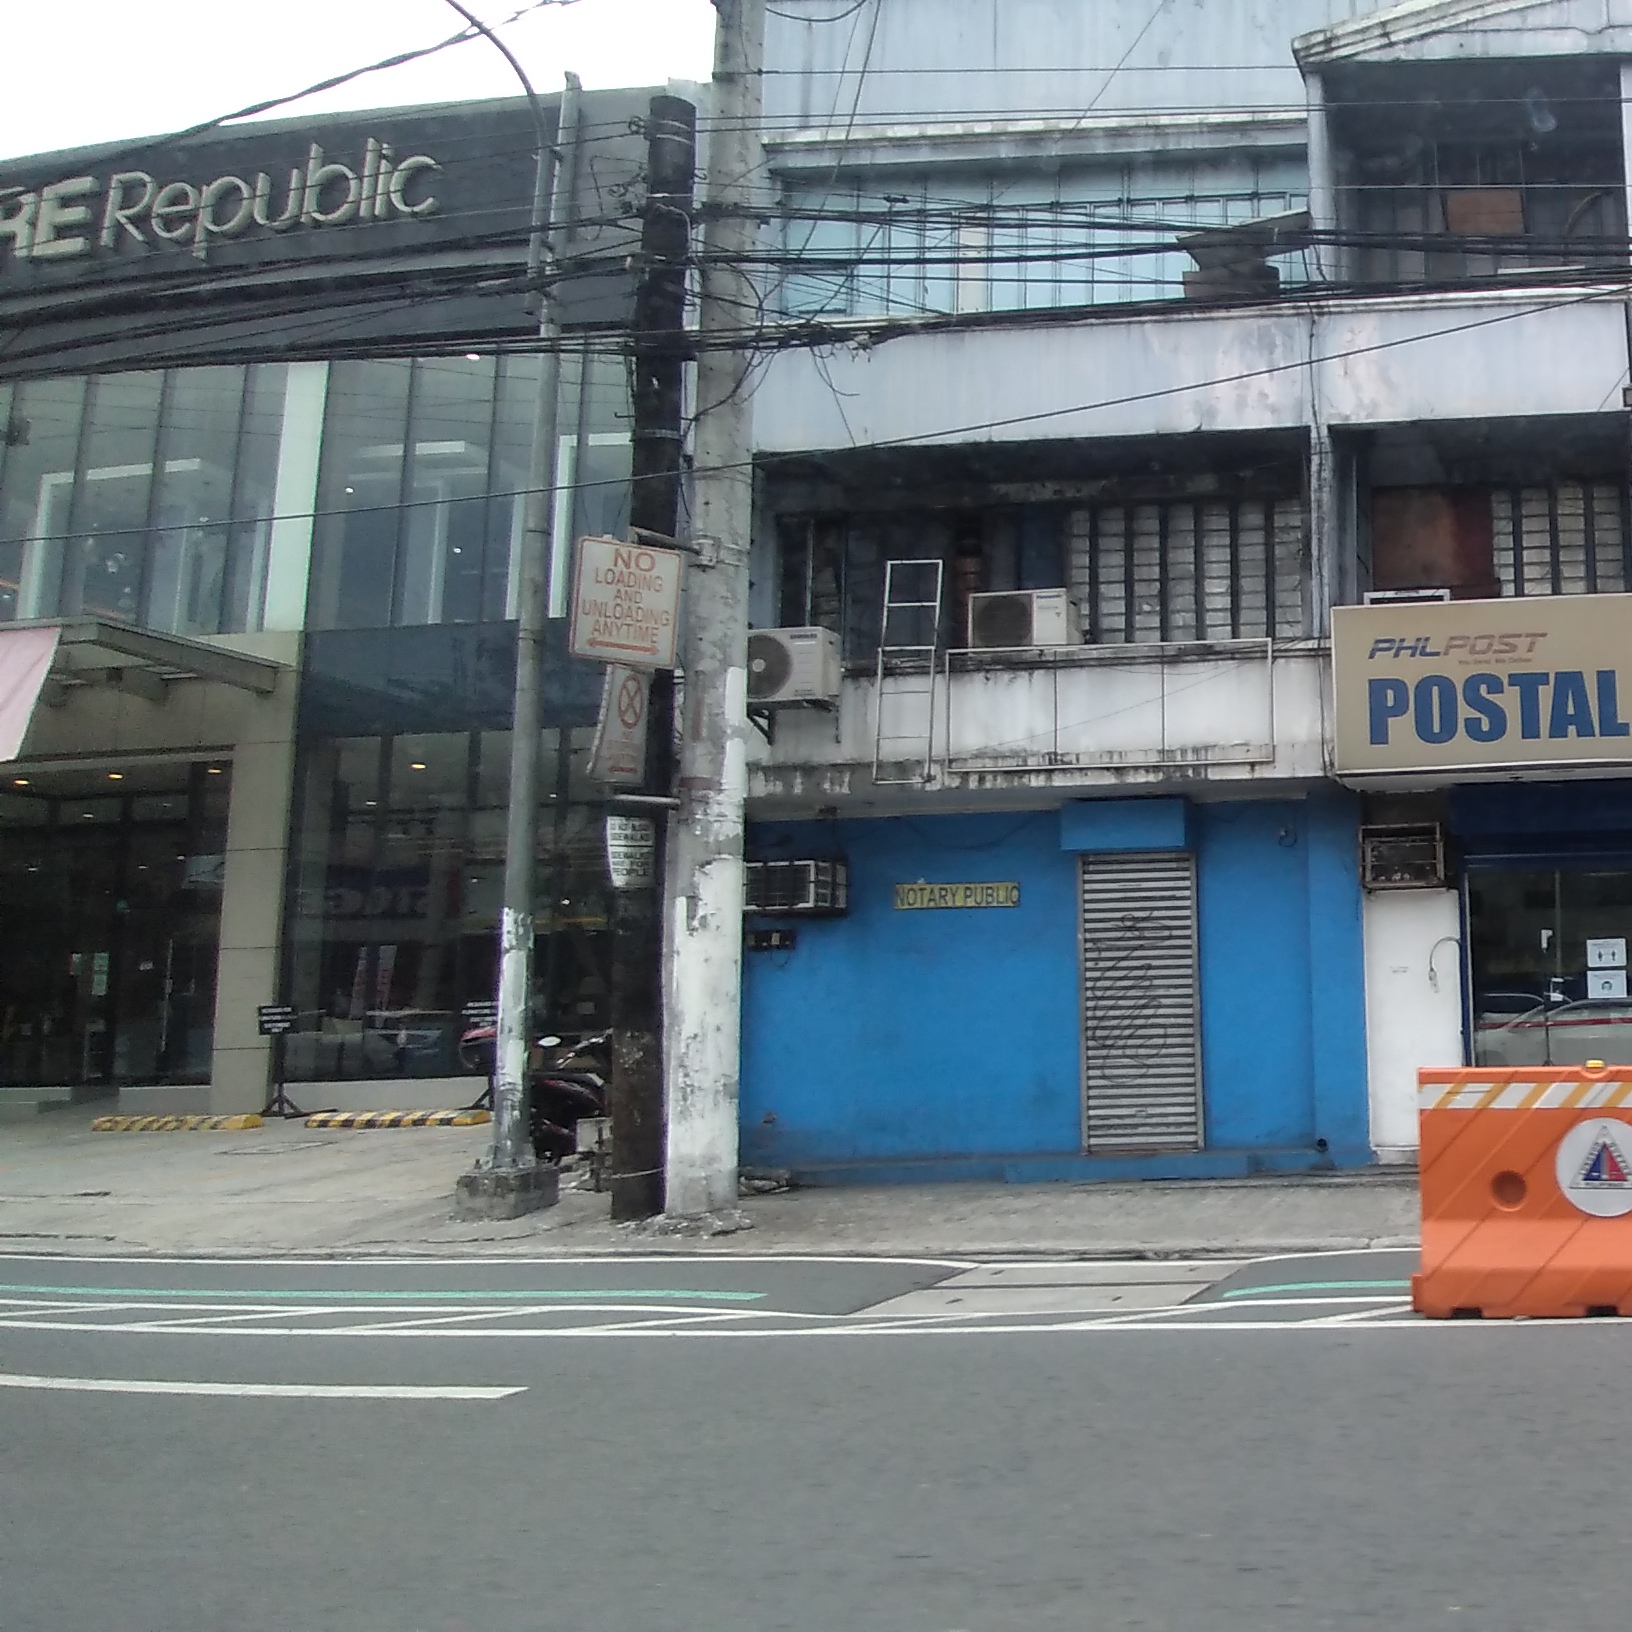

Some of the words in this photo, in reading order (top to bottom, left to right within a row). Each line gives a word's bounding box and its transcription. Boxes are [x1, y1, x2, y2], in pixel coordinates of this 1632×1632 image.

[100, 137, 443, 262] Republic
[613, 548, 656, 573] NO
[595, 567, 663, 593] LOADING
[613, 588, 643, 604] AND
[582, 599, 670, 627] UNLOADING
[591, 619, 659, 644] ANYTIME
[1367, 632, 1548, 660] PHLPOST
[1367, 669, 1631, 746] POSTAL
[895, 887, 959, 908] NOTARY
[964, 885, 1020, 905] PUBLIC
